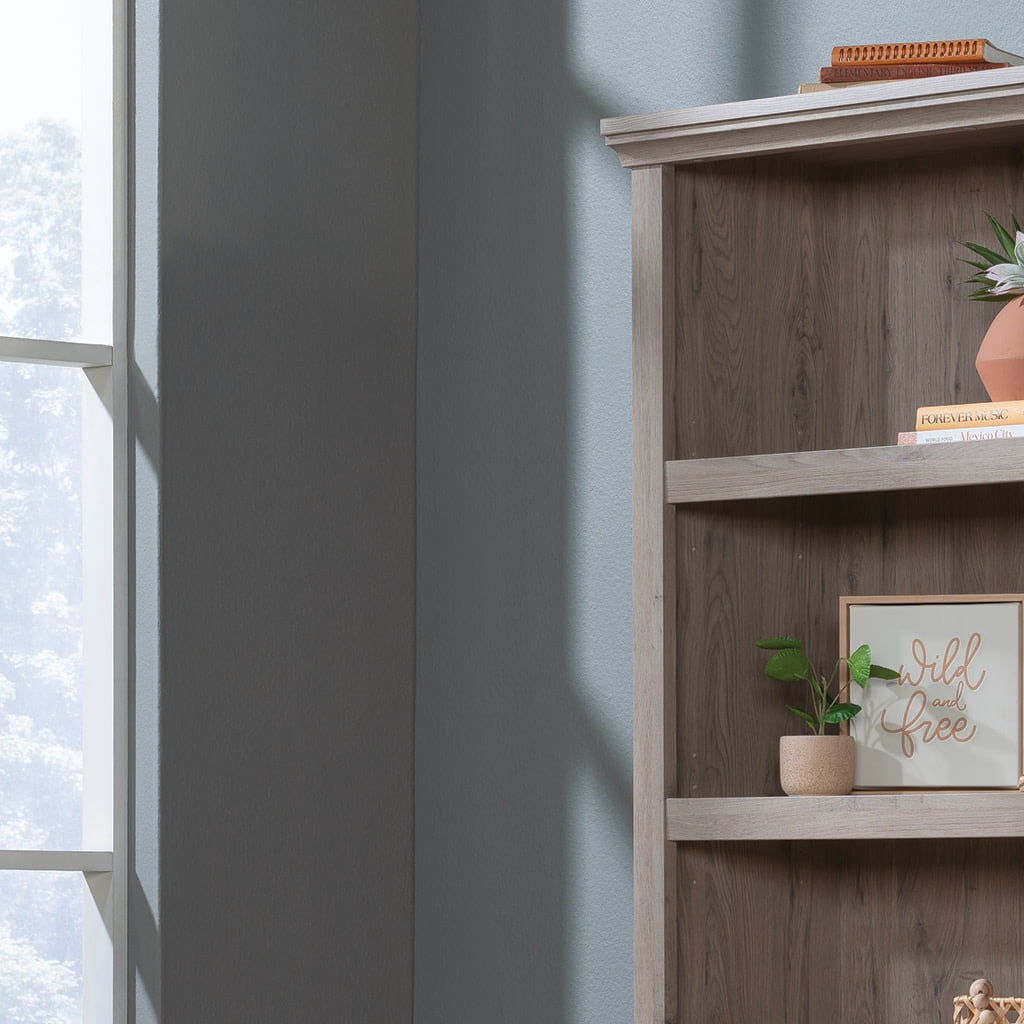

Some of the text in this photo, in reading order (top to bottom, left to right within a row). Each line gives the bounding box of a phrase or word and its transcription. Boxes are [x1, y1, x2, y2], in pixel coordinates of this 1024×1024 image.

[834, 67, 891, 78] ELEMENTARY
[921, 409, 1009, 425] FOREVER MUSIC
[960, 431, 993, 442] Mexico
[898, 632, 986, 691] wild
[932, 681, 967, 712] and
[881, 690, 977, 758] free
